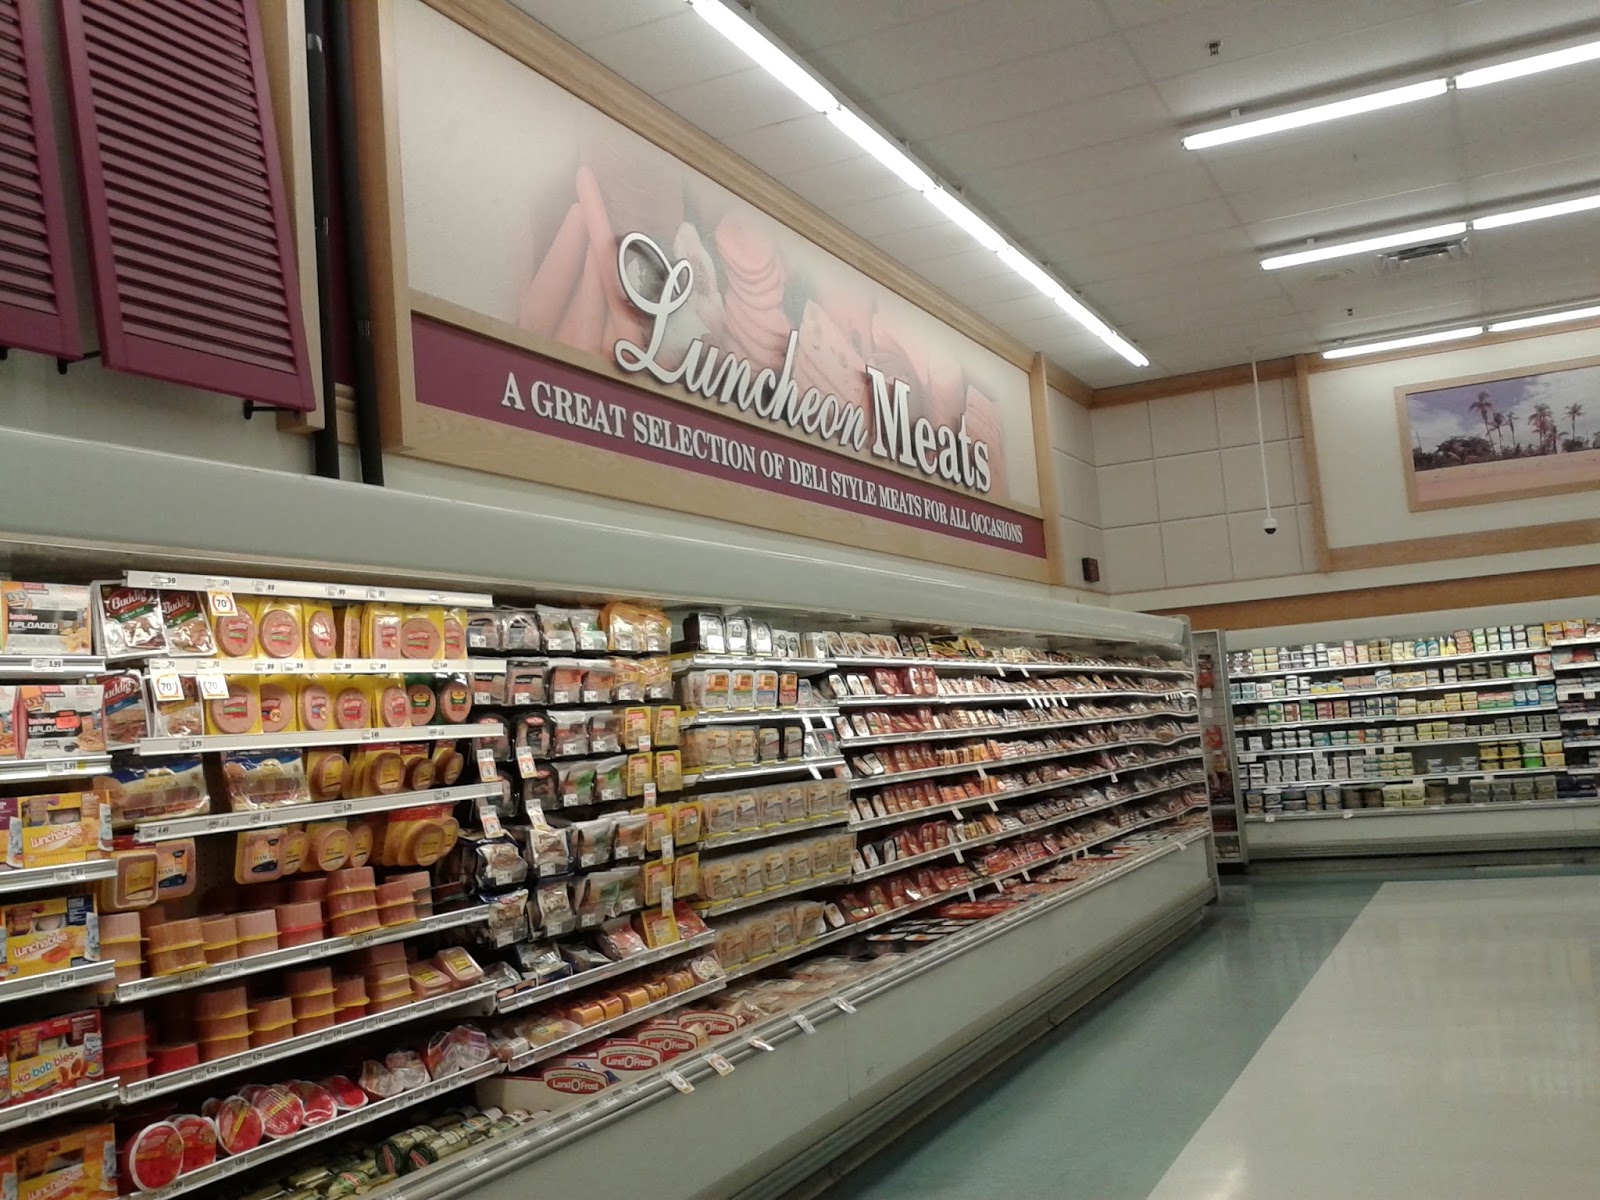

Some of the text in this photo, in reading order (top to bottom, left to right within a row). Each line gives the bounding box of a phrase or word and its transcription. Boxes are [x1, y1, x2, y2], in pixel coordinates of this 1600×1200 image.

[614, 231, 992, 494] Luncheon Meats
[501, 372, 1025, 544] A GREAT SELECTION OF DELI STYLE MEATS FOR ALL OCCASIONS
[9, 621, 59, 630] UPLOADED
